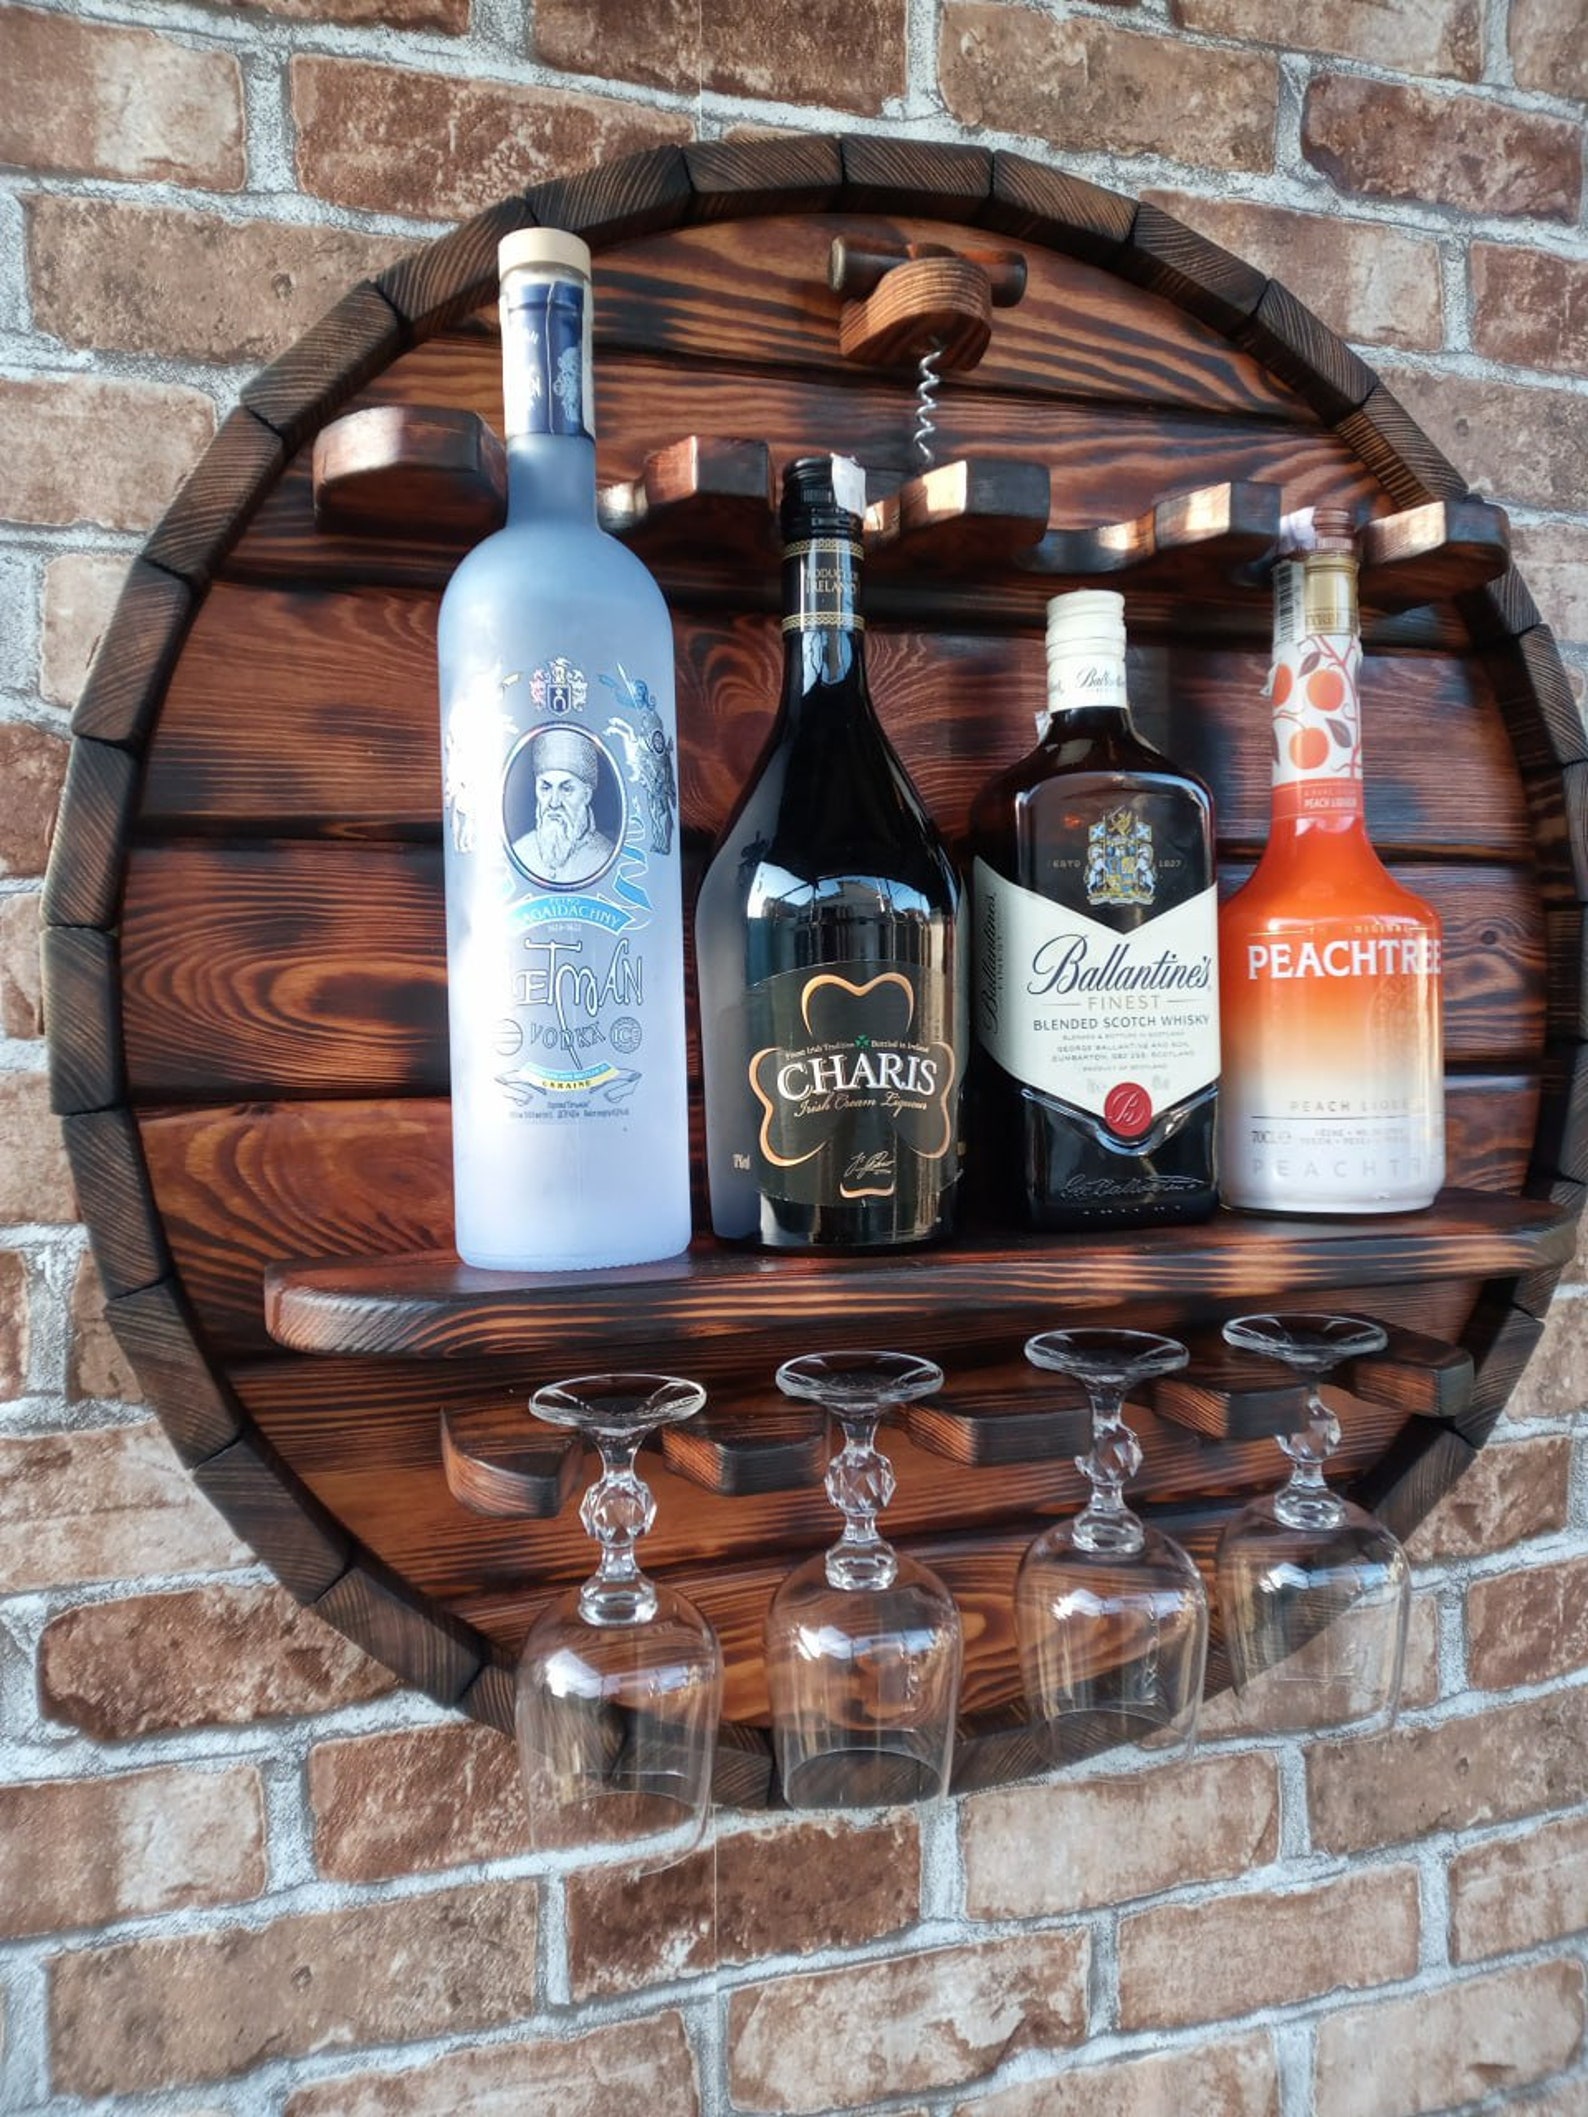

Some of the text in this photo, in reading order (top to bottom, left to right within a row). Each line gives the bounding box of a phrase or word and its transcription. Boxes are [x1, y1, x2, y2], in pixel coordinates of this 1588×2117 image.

[1027, 934, 1211, 995] Ballantine's
[1248, 938, 1441, 980] PEACHTREE
[1088, 995, 1161, 1010] FINEST
[530, 1021, 606, 1050] VODKA
[1033, 1014, 1210, 1031] BLENDED SCOTCH WHISKY
[777, 1052, 938, 1102] CHARIS
[793, 1091, 928, 1118] Irish Cream Liqueur
[1290, 1101, 1350, 1112] PEACH
